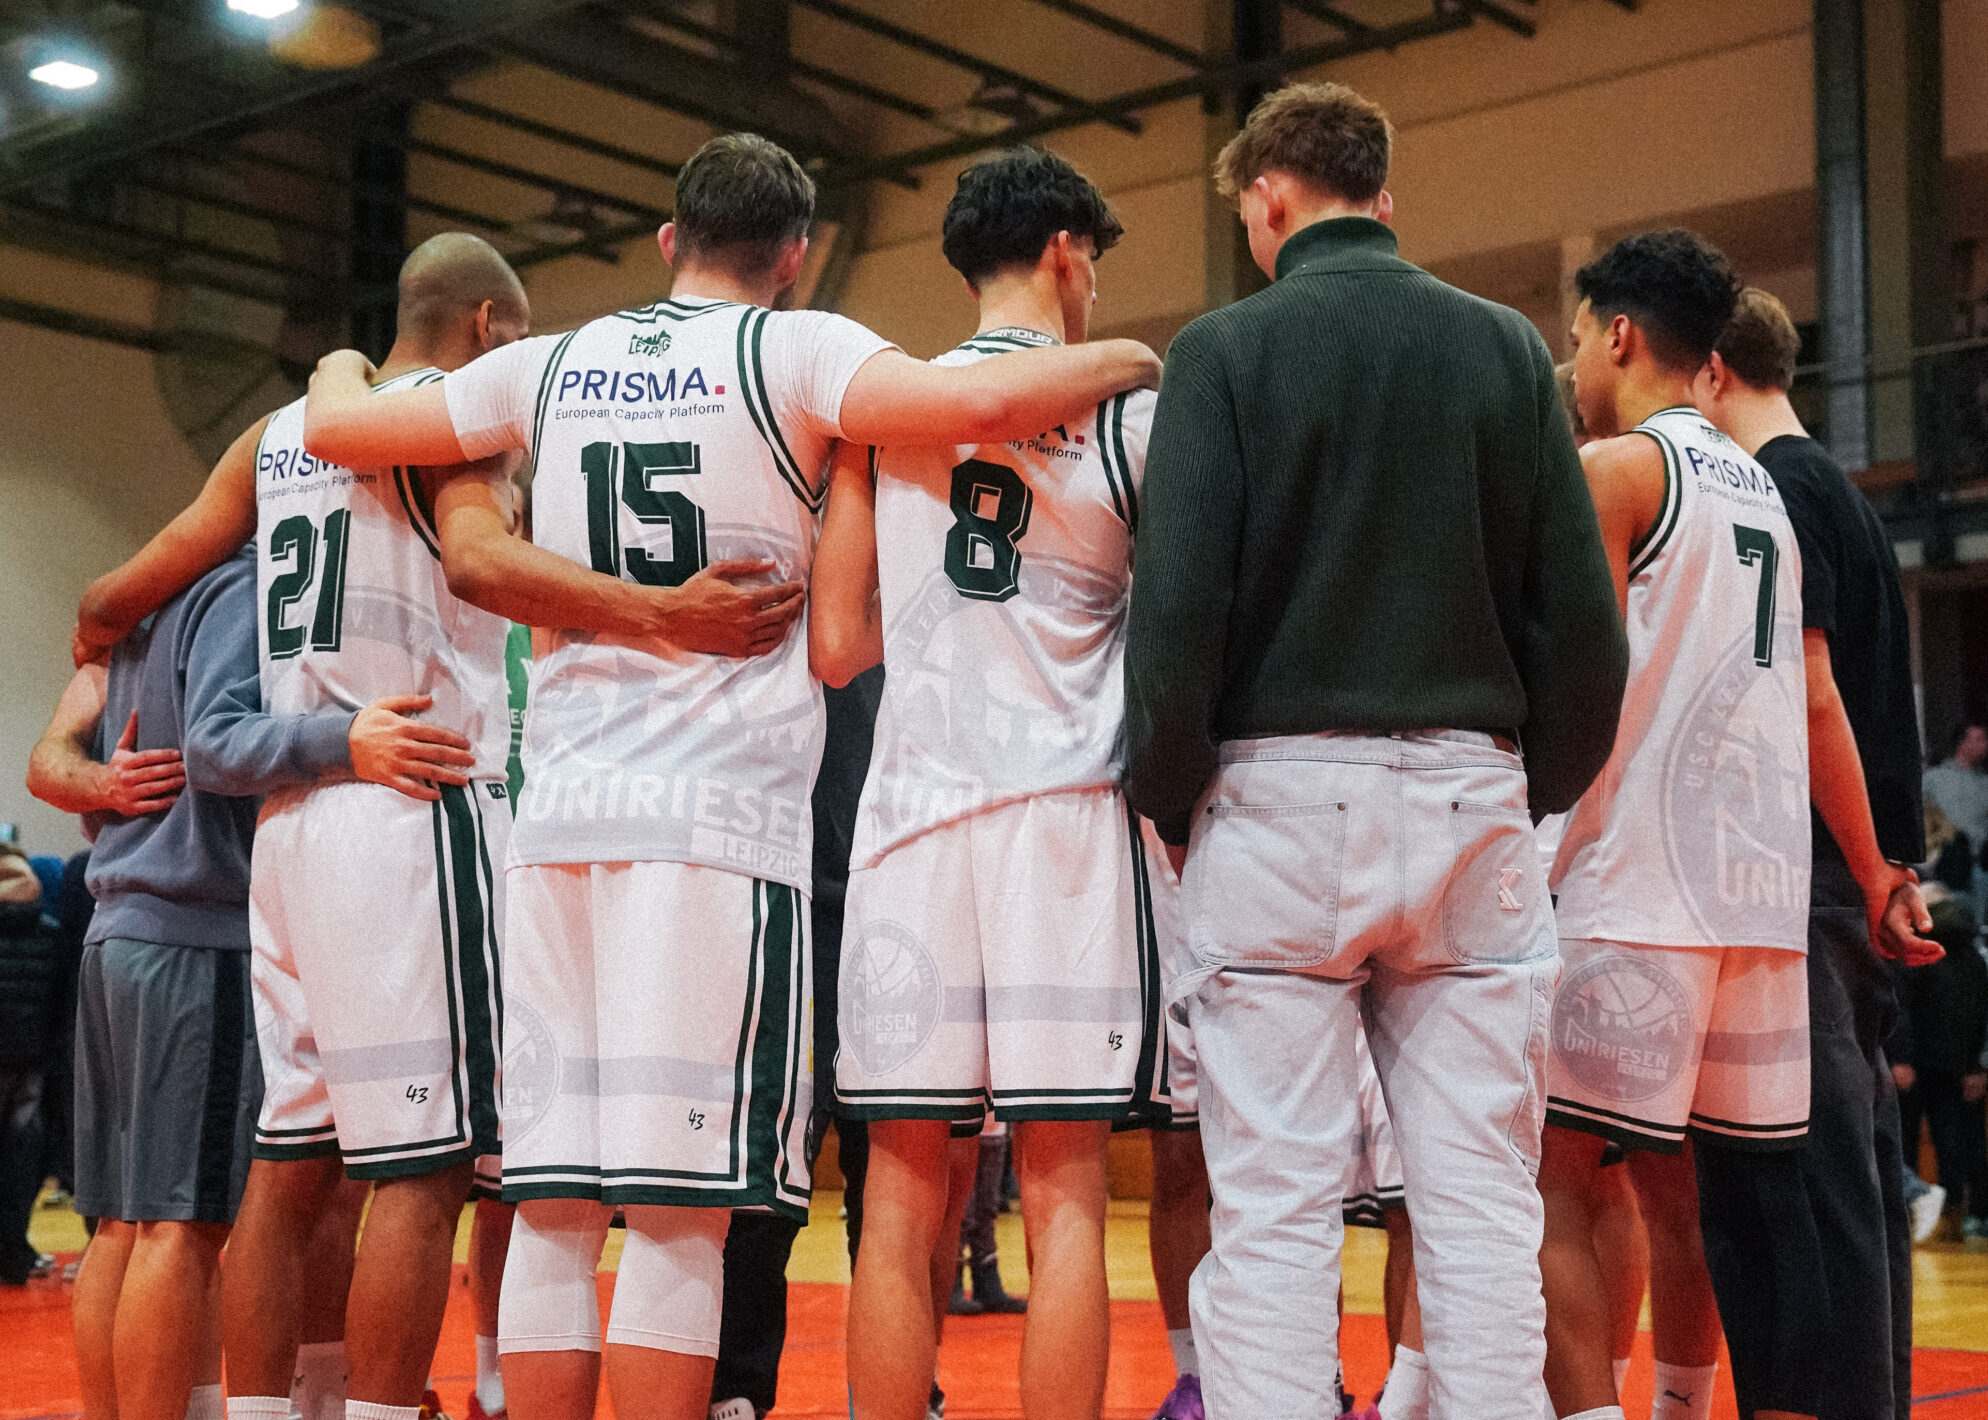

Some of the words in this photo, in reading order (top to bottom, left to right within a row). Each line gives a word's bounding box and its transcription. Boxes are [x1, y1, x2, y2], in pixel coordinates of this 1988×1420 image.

[628, 336, 671, 358] LEIPG
[556, 408, 610, 420] European
[669, 403, 725, 419] Platform
[1027, 440, 1083, 461] Platform
[580, 441, 708, 588] 15
[944, 458, 1033, 603] 8
[268, 507, 351, 660] 21
[1733, 523, 1779, 668] 7
[526, 756, 800, 844] UNIRIESE
[1108, 1030, 1123, 1051] 43
[406, 1084, 429, 1104] 43
[688, 1108, 705, 1130] 43
